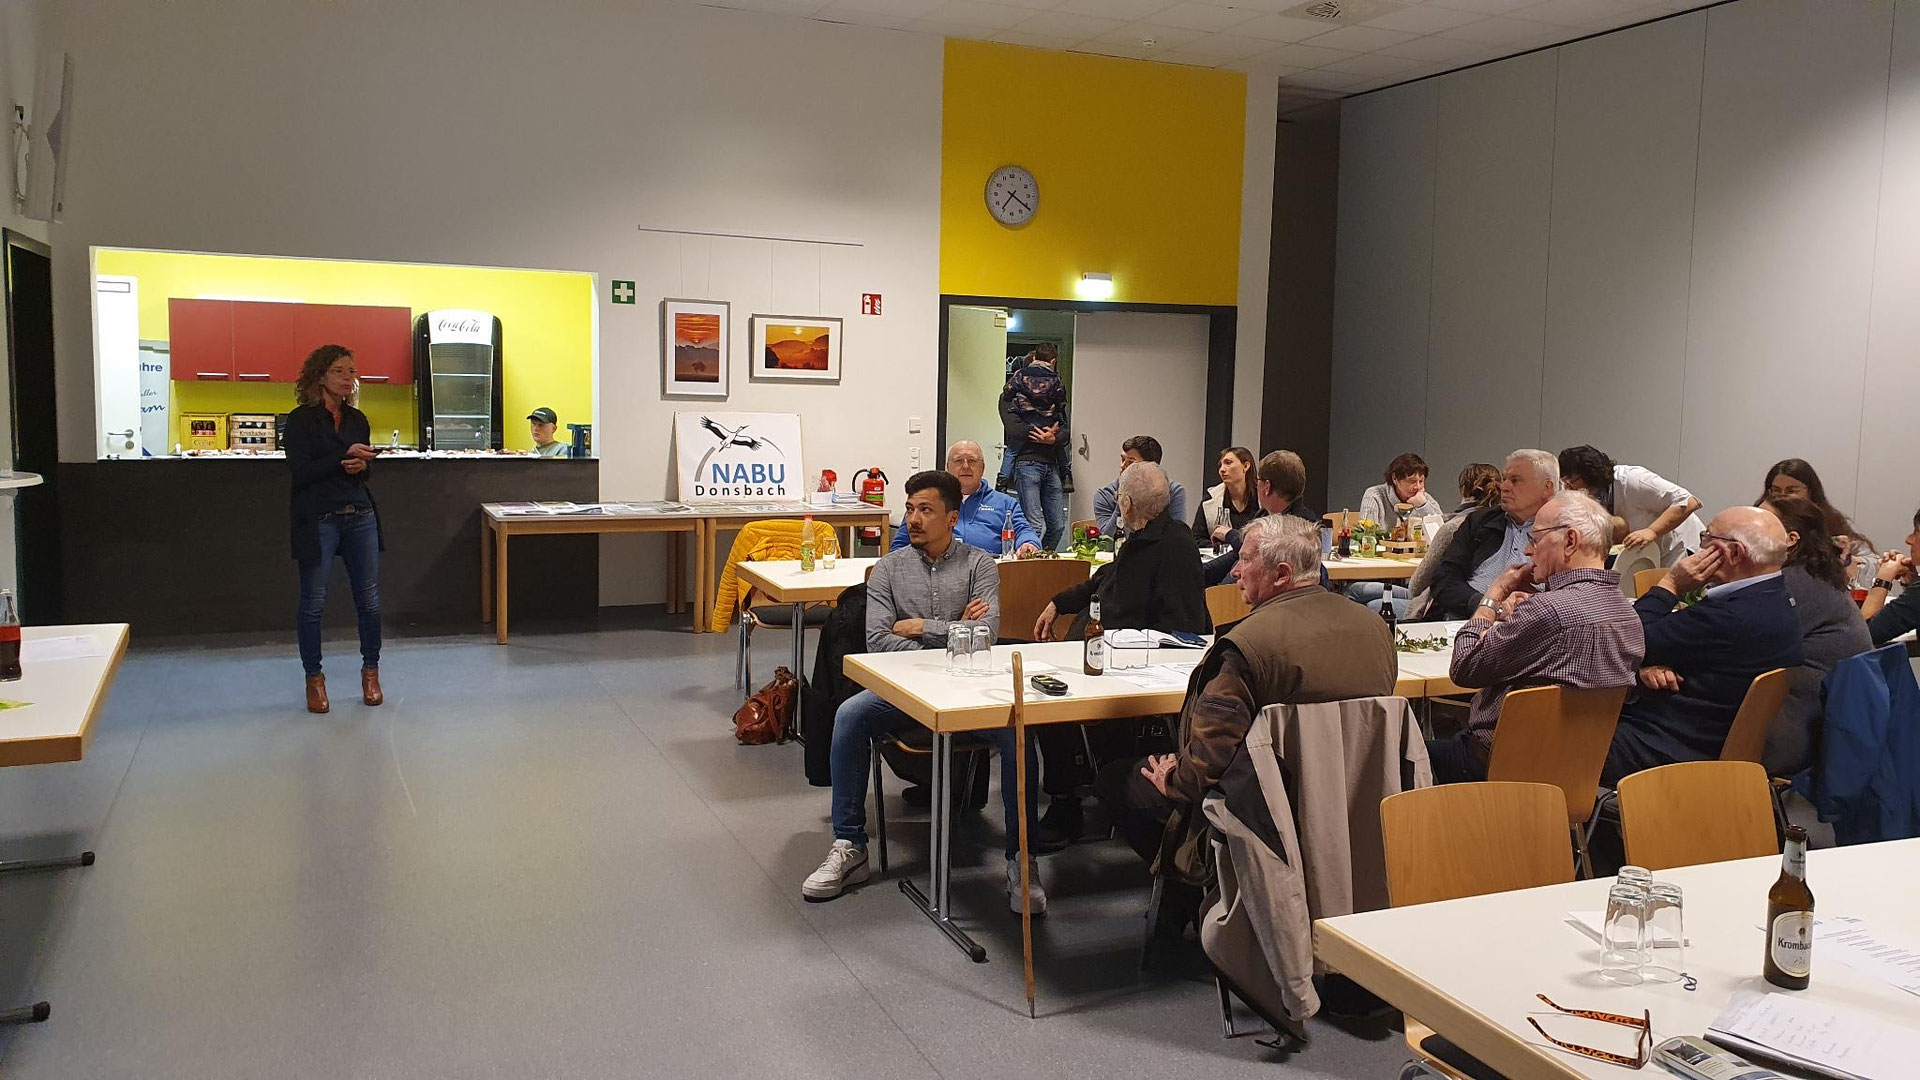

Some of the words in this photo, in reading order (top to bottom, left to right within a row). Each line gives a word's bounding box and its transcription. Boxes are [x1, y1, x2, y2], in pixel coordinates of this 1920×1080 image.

[140, 362, 163, 372] hre
[712, 463, 786, 484] NABU
[695, 484, 786, 496] Donsbach
